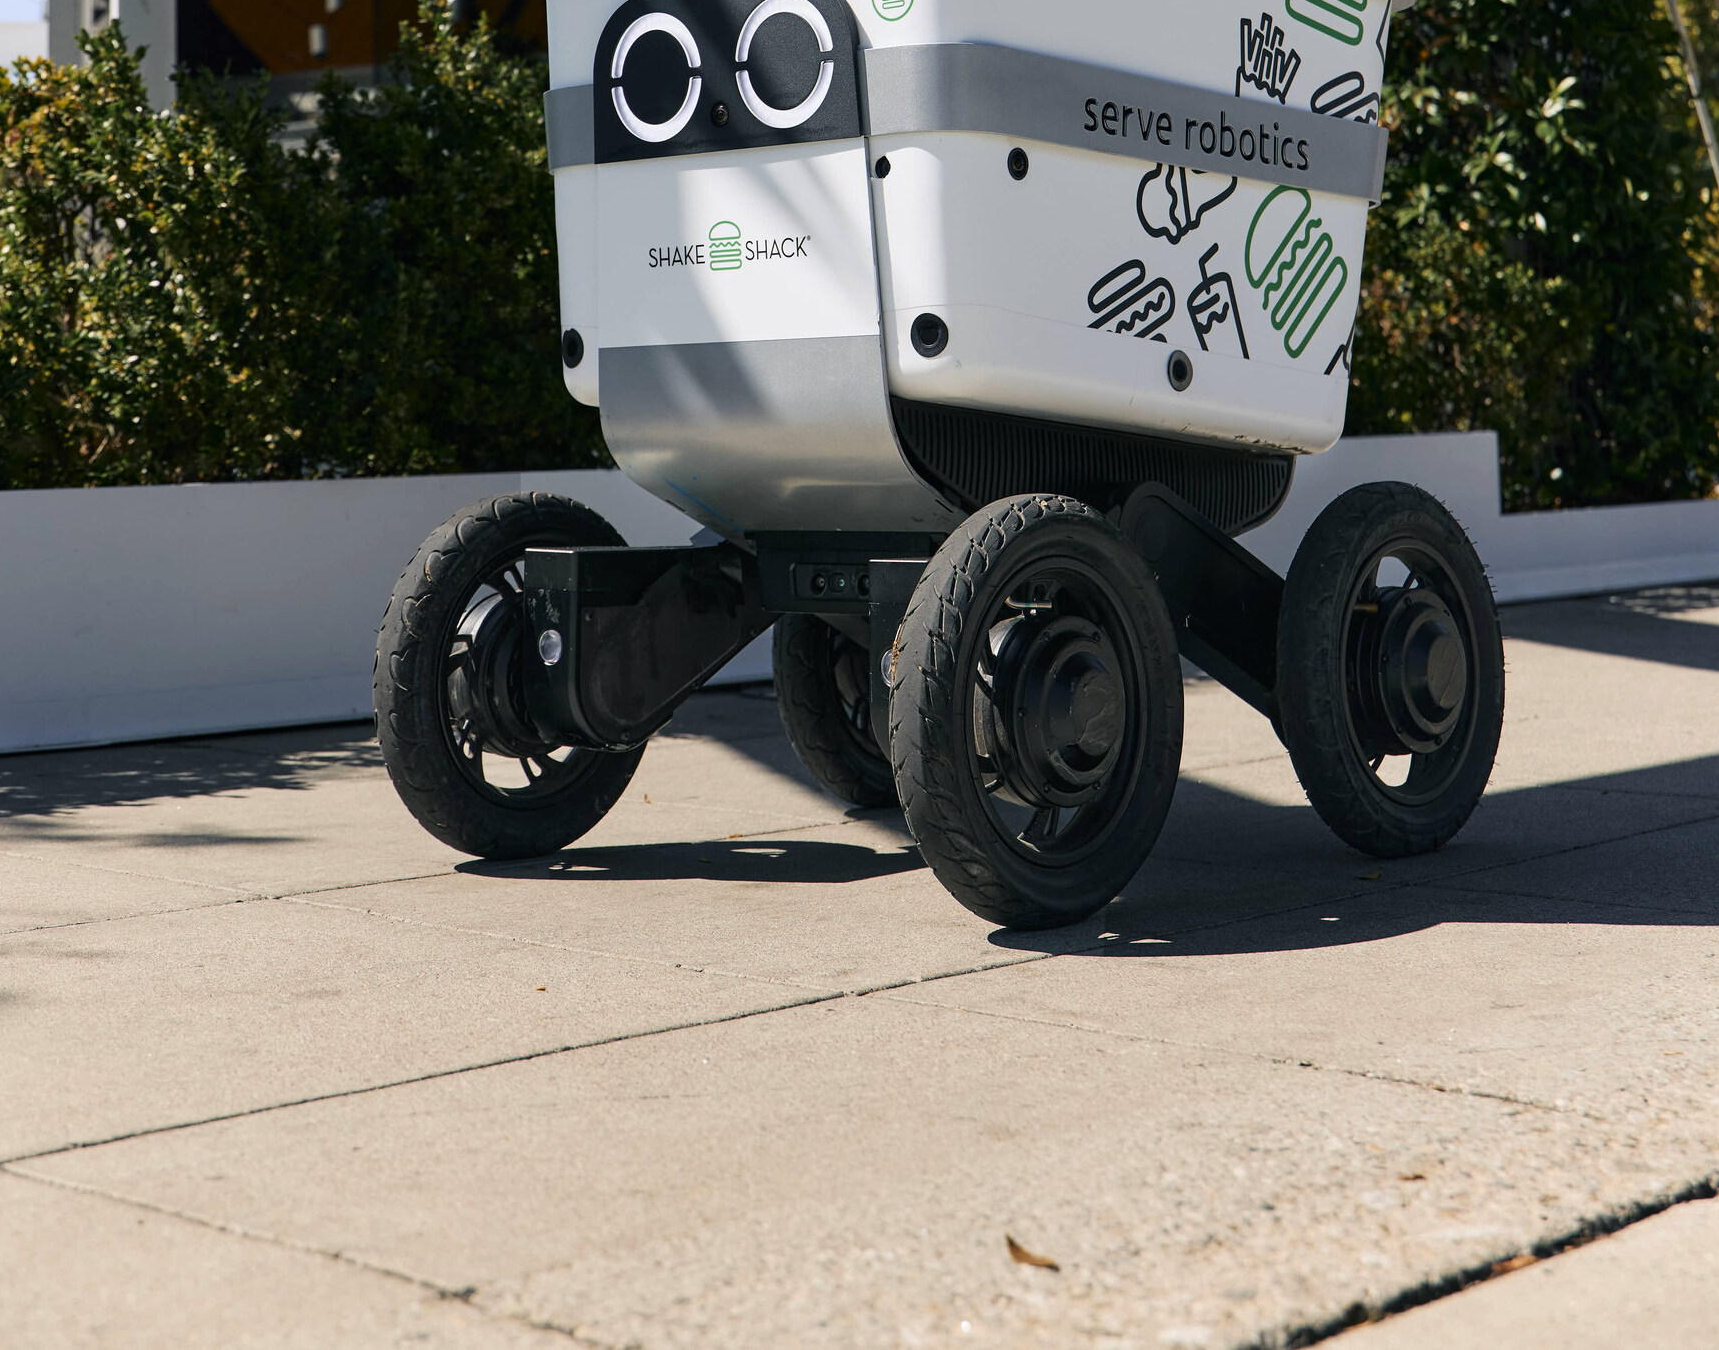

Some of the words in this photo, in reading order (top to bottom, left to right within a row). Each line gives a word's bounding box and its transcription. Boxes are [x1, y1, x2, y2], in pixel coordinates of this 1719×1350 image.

[1083, 97, 1174, 146] serve
[1184, 109, 1311, 172] robotics
[648, 244, 706, 268] SHAKE
